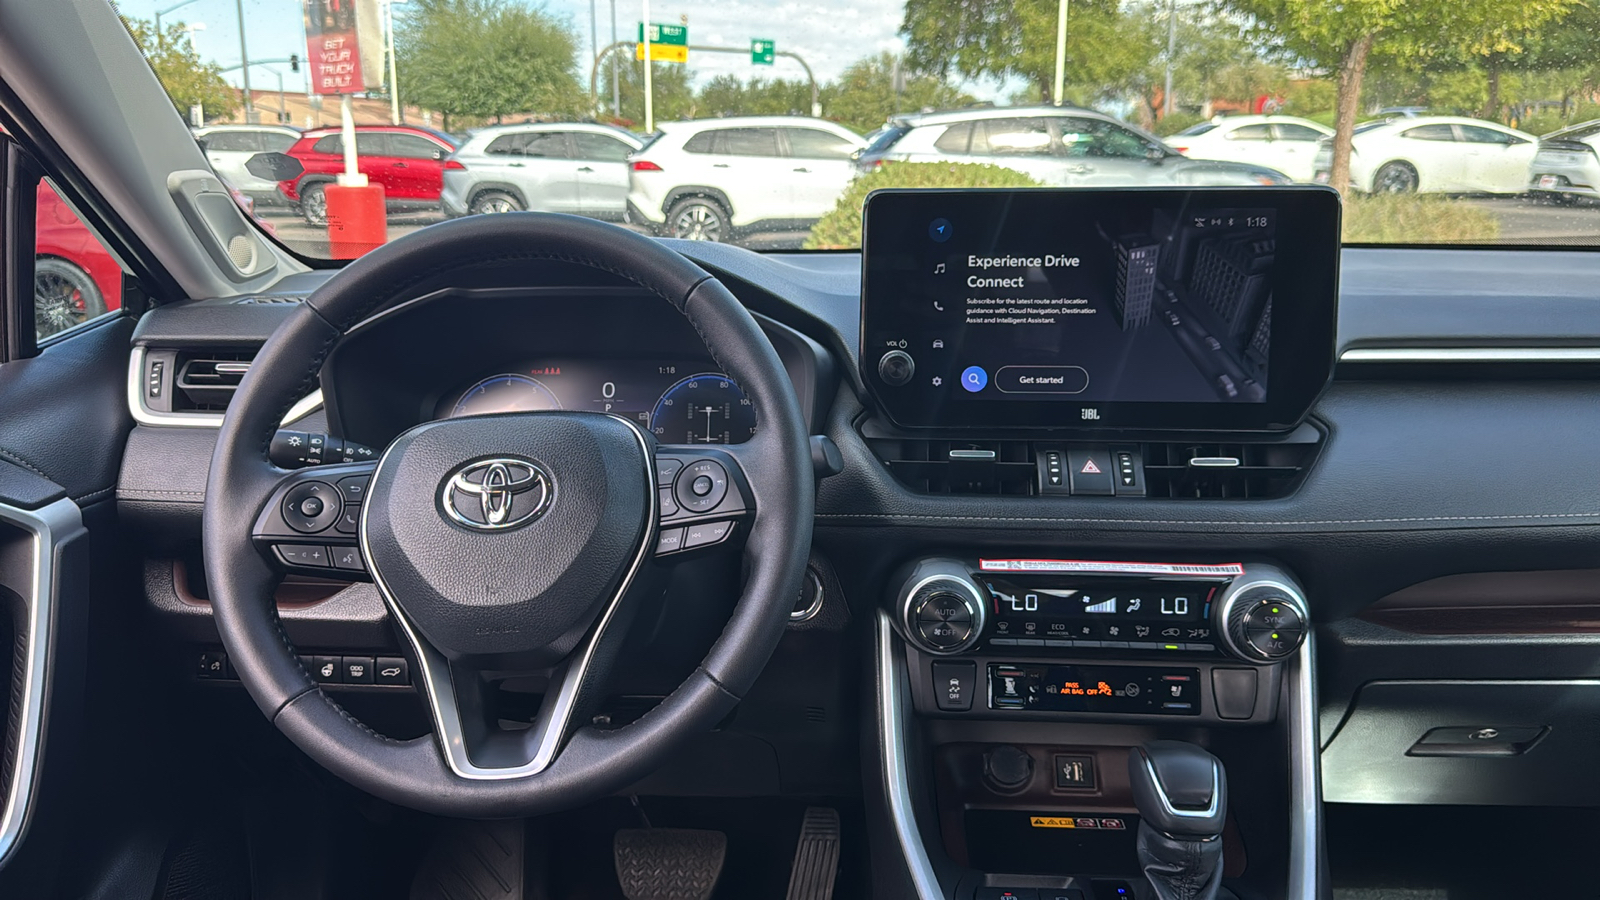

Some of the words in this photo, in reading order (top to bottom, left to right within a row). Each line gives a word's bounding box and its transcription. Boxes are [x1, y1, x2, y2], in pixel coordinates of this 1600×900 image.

[320, 50, 351, 62] YOUR
[318, 62, 354, 75] TRUCK
[322, 76, 352, 88] BUILT
[1246, 217, 1268, 227] 1:18
[968, 254, 1042, 270] Experience
[1044, 254, 1080, 267] Drive
[967, 275, 1024, 288] Connect
[966, 307, 994, 315] guidance
[1027, 307, 1061, 315] Navigation,
[996, 317, 1027, 325] Intelligent
[506, 379, 512, 387] 4
[1019, 375, 1035, 384] Get
[1035, 375, 1064, 384] started
[688, 381, 698, 389] 60
[719, 381, 729, 389] 80
[480, 386, 486, 394] 3
[532, 386, 537, 394] 5
[663, 398, 674, 406] 40
[605, 403, 612, 412] P
[1081, 408, 1100, 420] JBL
[655, 426, 665, 435] 20
[661, 536, 678, 545] MODE
[1011, 594, 1038, 612] LO
[1160, 597, 1189, 615] LO
[934, 608, 956, 616] AUTO
[1264, 616, 1285, 624] SYNC
[1051, 623, 1066, 631] ECO
[941, 629, 957, 637] OFF
[1266, 640, 1285, 649] A/C
[1086, 688, 1098, 696] OFF
